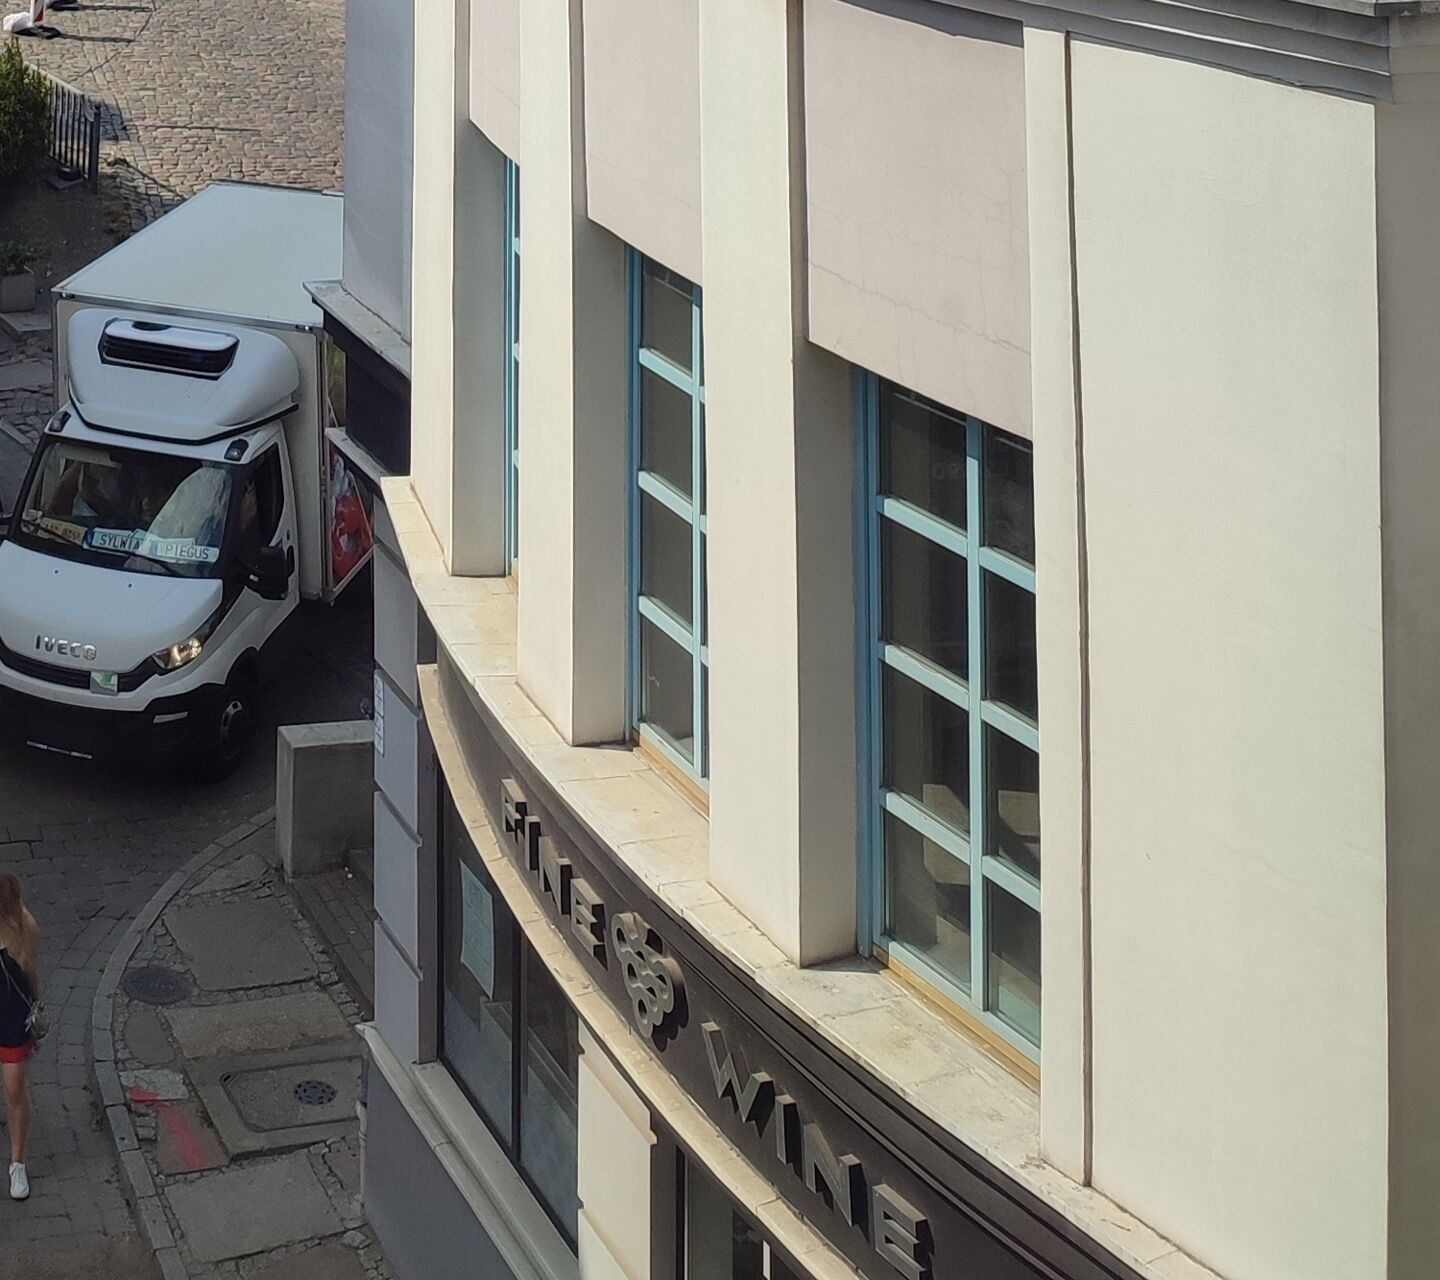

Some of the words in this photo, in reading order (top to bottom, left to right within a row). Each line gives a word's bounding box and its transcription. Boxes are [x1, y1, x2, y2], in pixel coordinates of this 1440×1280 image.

[164, 543, 210, 560] PIEGUS
[35, 635, 97, 661] IVECO
[500, 778, 607, 960] FINE
[700, 1020, 936, 1279] WINE
